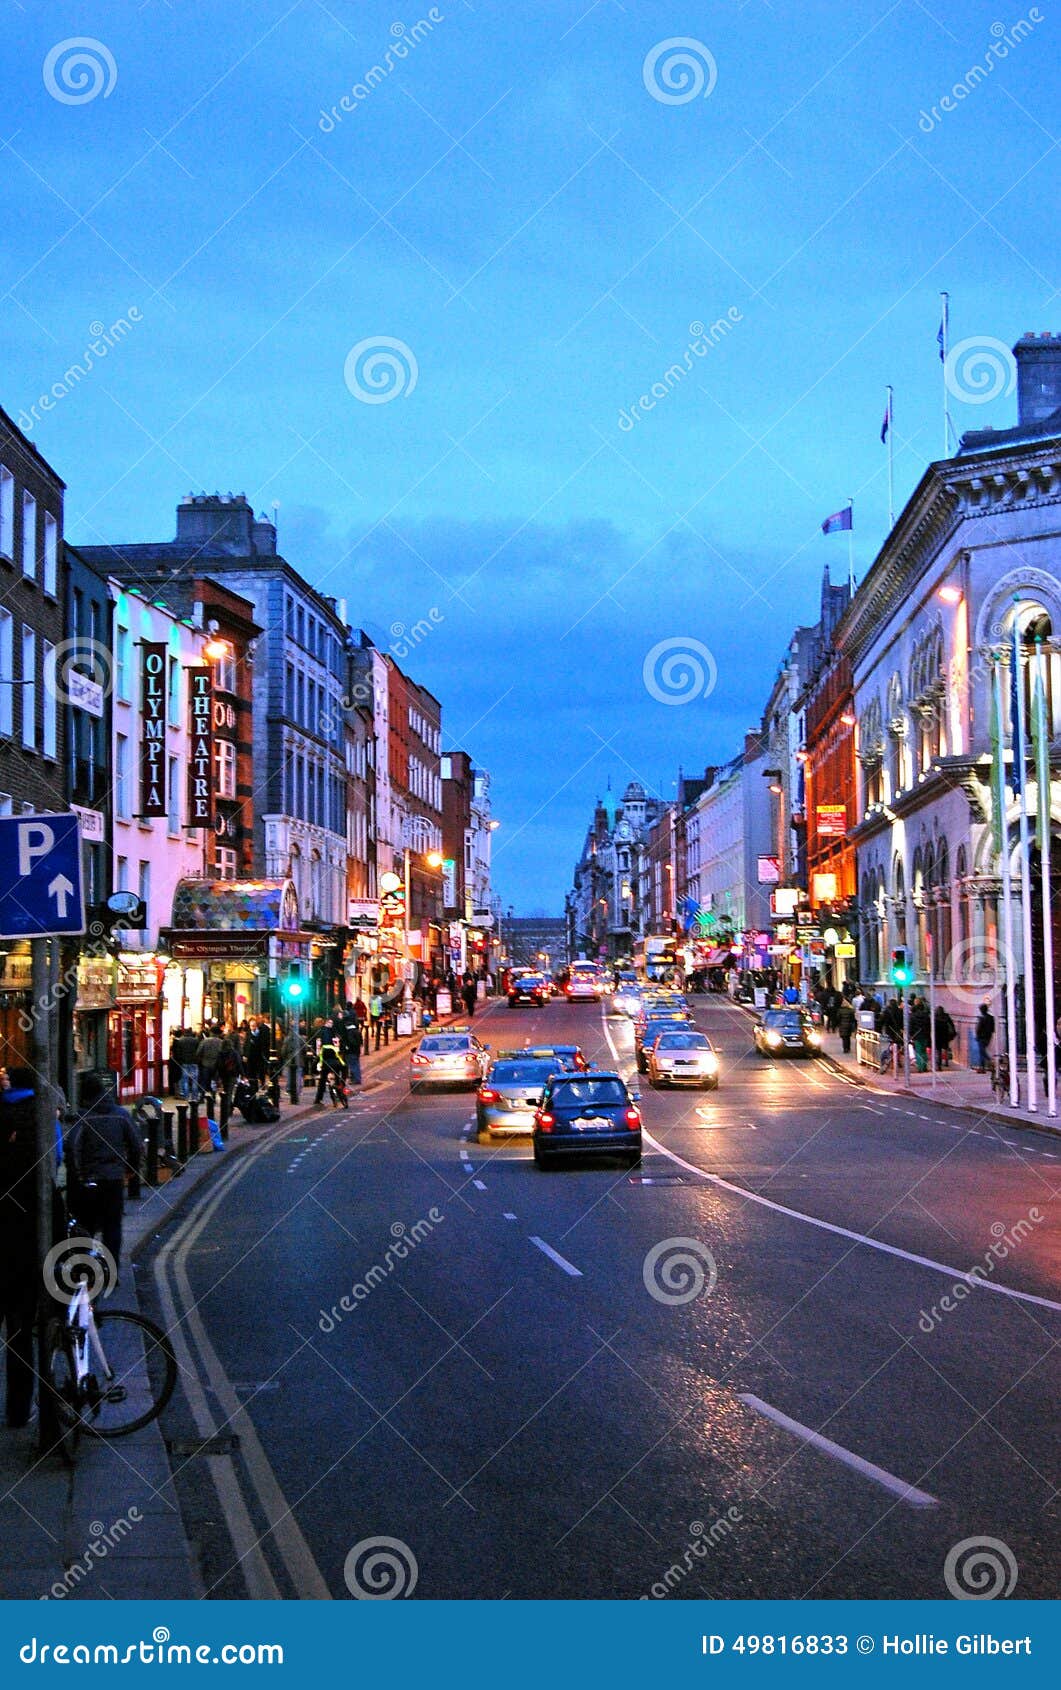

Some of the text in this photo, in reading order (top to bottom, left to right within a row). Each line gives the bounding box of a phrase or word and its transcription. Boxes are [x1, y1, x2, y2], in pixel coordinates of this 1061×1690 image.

[146, 654, 163, 805] OLYMPIA
[194, 677, 211, 817] THEATRE
[18, 822, 55, 876] P
